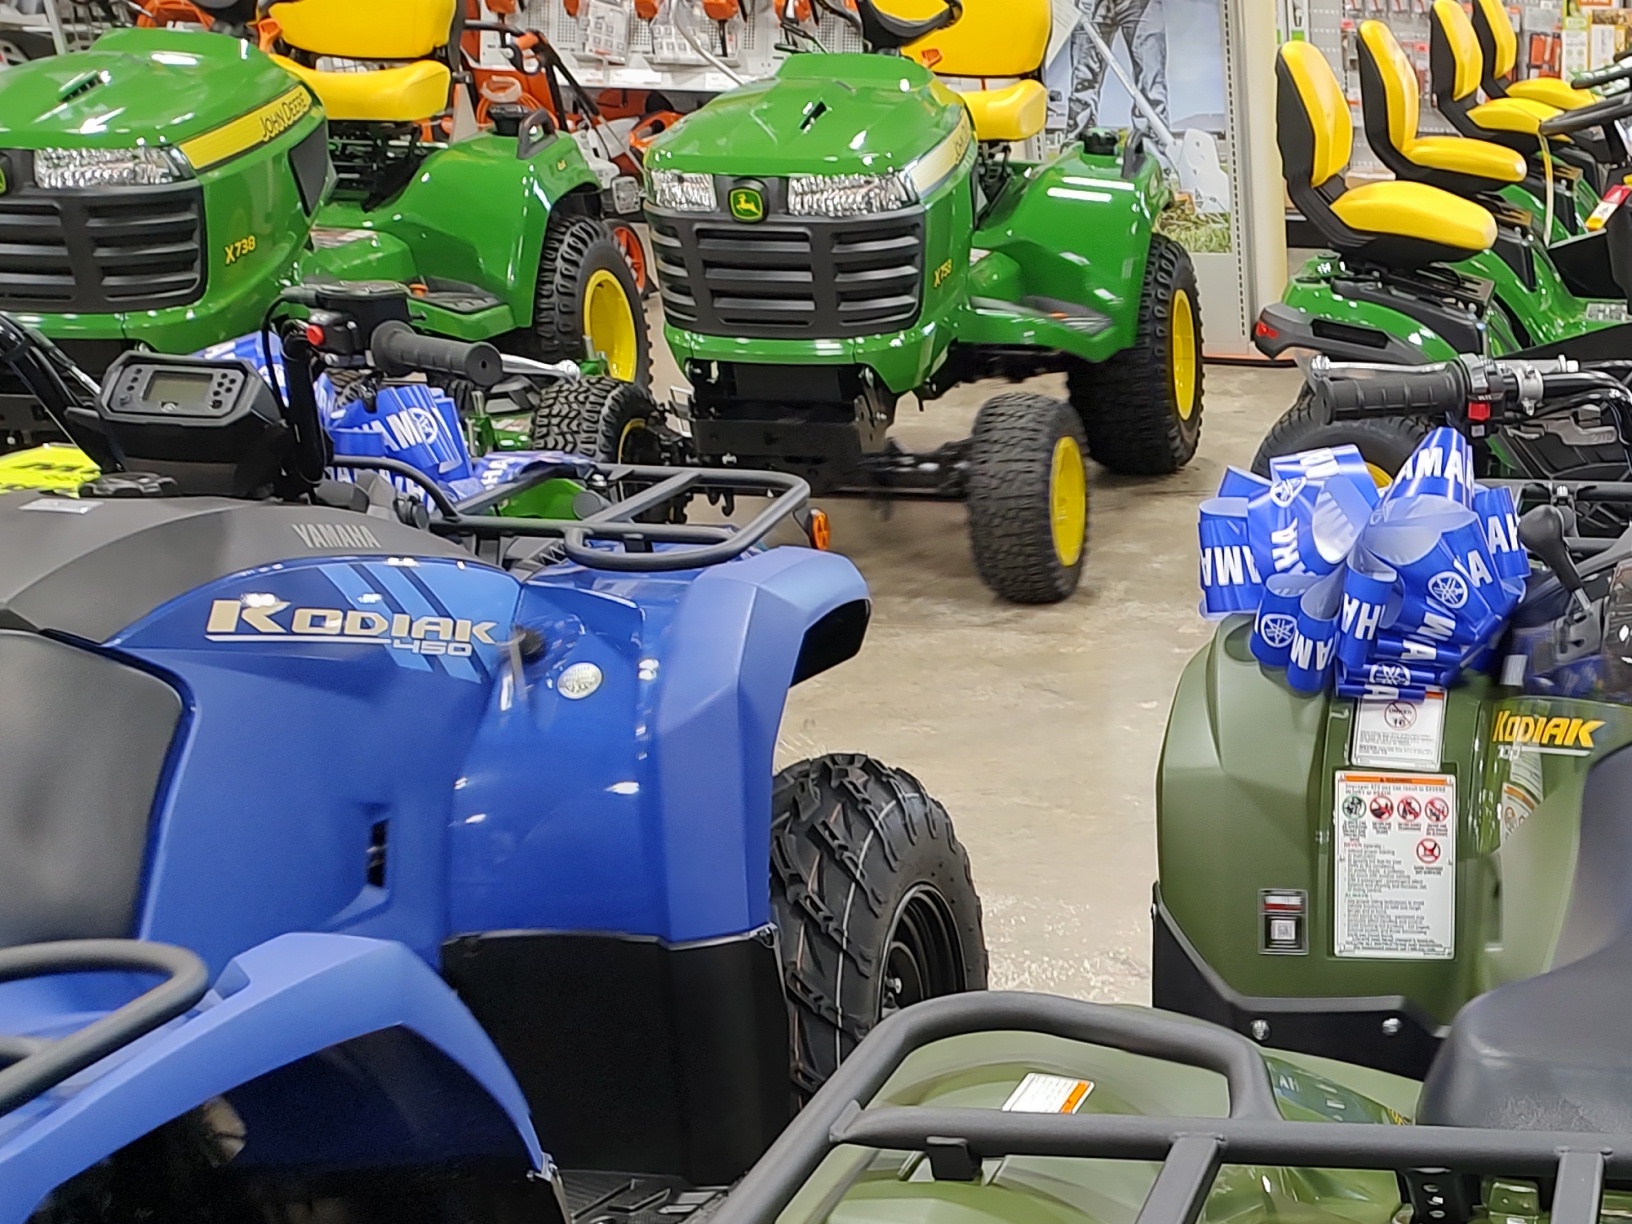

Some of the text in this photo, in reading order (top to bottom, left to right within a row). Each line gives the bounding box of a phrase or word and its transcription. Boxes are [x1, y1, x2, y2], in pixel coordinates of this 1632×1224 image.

[259, 108, 286, 139] JOHN
[224, 235, 256, 266] X738
[291, 523, 382, 549] YAMAHA
[205, 598, 498, 645] KODIAK
[393, 640, 473, 657] 450
[1492, 710, 1606, 748] KODIAK
